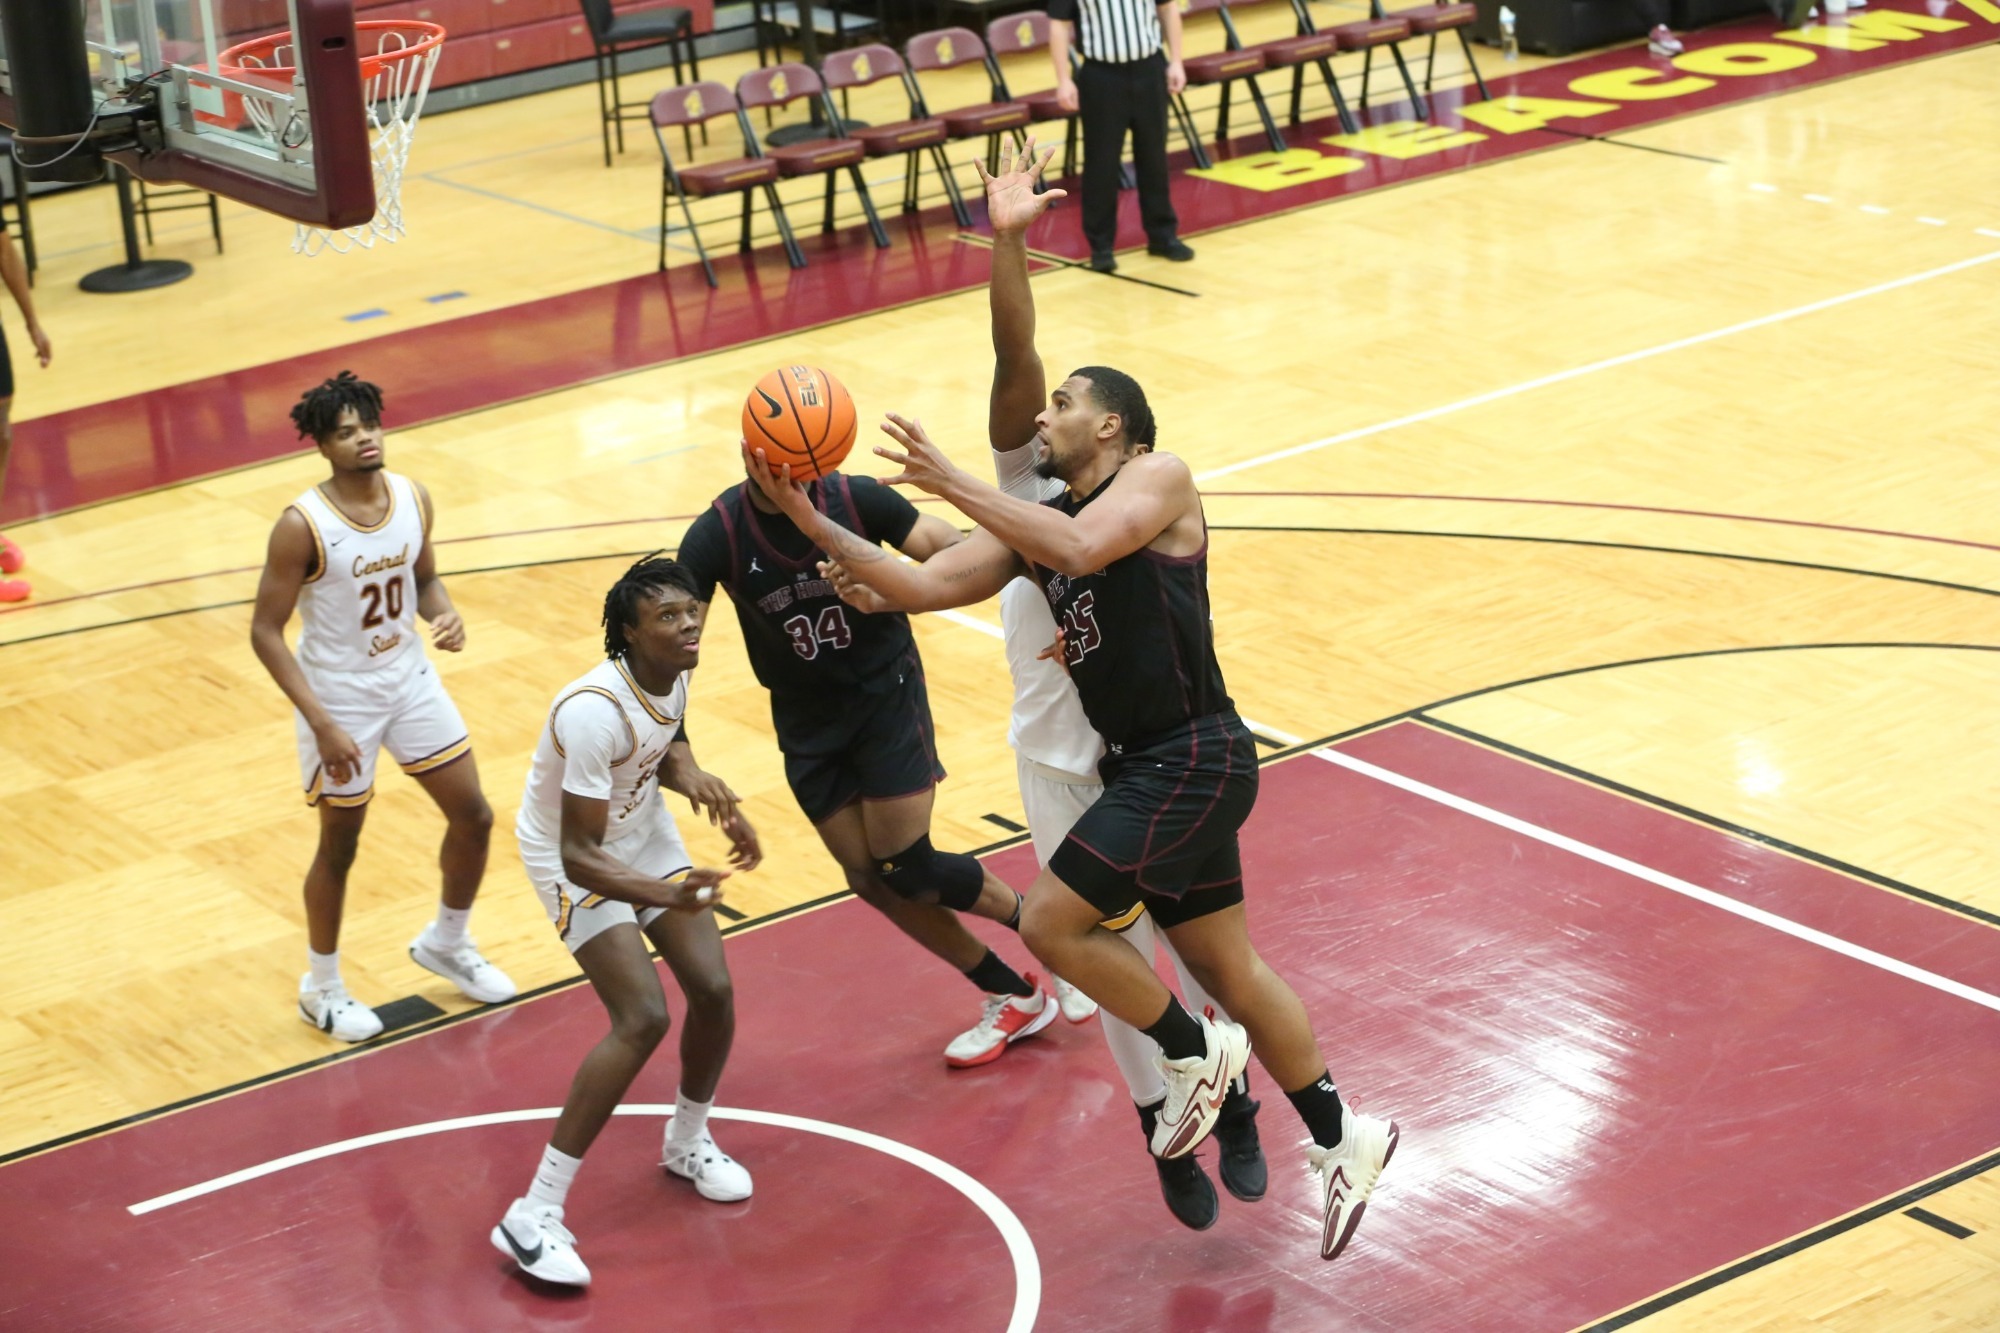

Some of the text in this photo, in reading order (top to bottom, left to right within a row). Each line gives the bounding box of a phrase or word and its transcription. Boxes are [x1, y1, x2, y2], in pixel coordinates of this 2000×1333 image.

[352, 542, 408, 578] Central
[360, 574, 403, 631] 20
[757, 580, 837, 614] THE HOU
[783, 605, 852, 661] 34
[1064, 589, 1102, 667] 25
